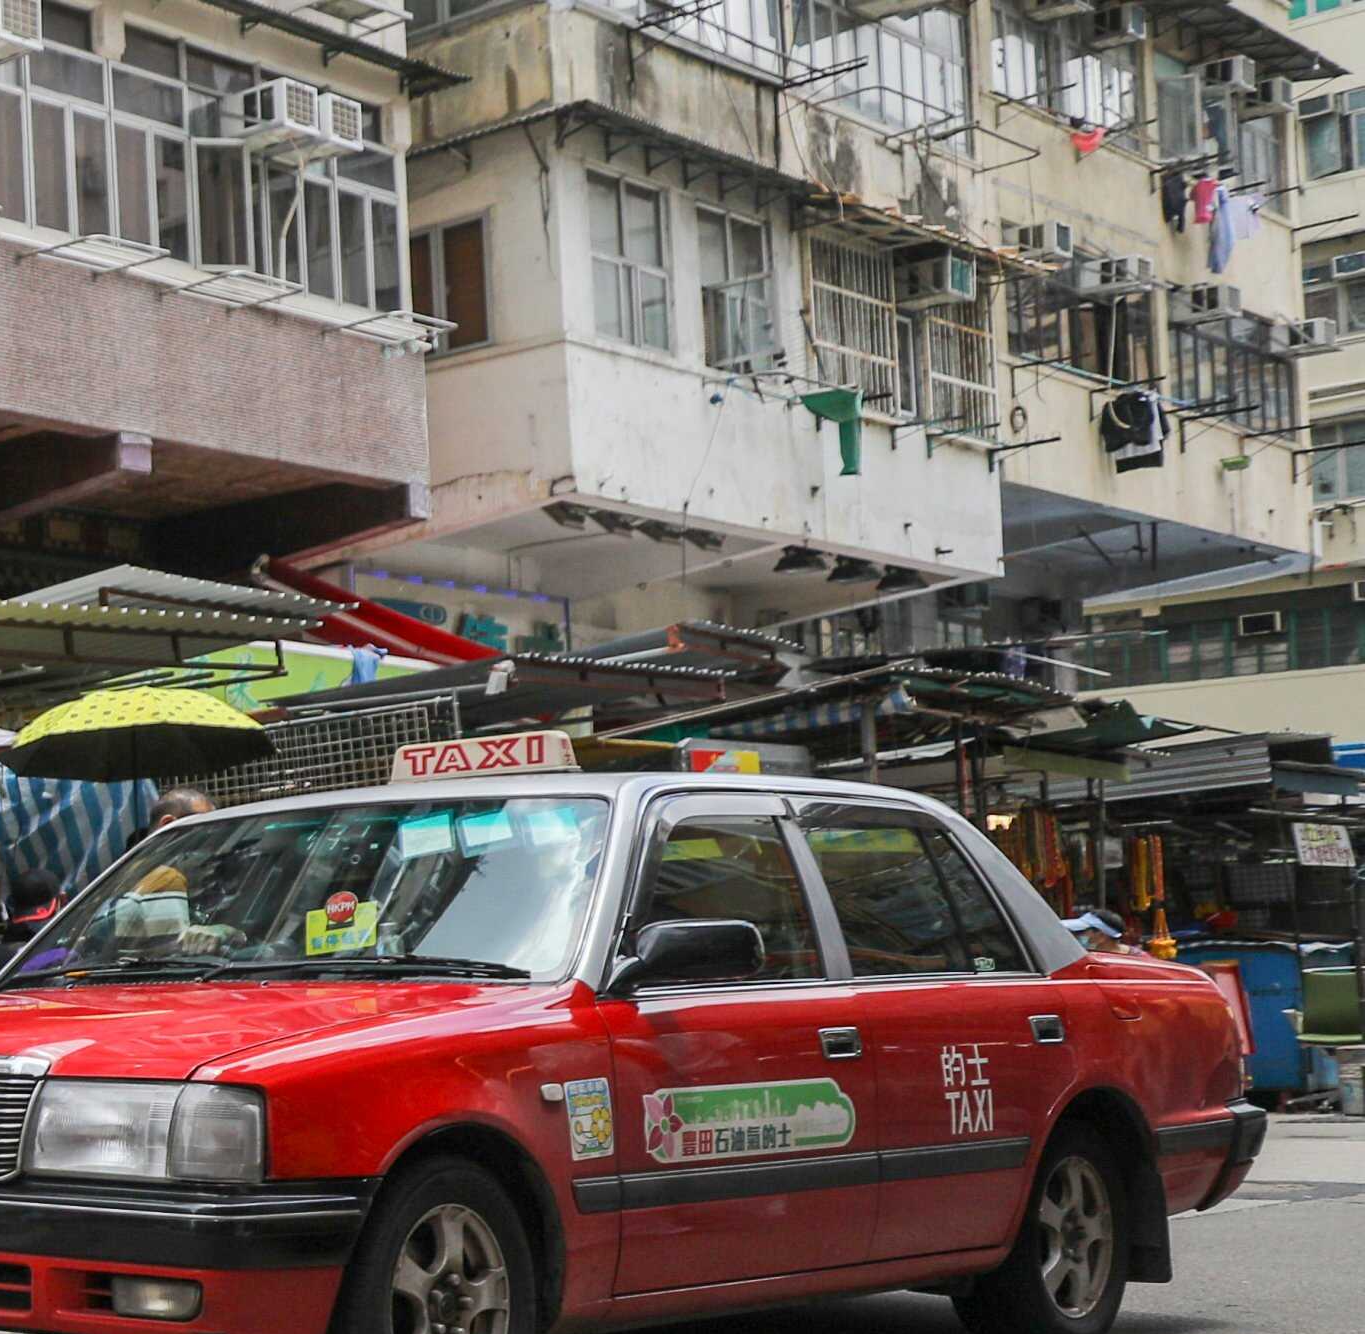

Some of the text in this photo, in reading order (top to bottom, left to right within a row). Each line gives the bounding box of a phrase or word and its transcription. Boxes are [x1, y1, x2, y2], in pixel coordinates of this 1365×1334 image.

[403, 735, 544, 776] TAXI
[941, 1043, 990, 1087] 的士
[945, 1089, 994, 1135] TAXI
